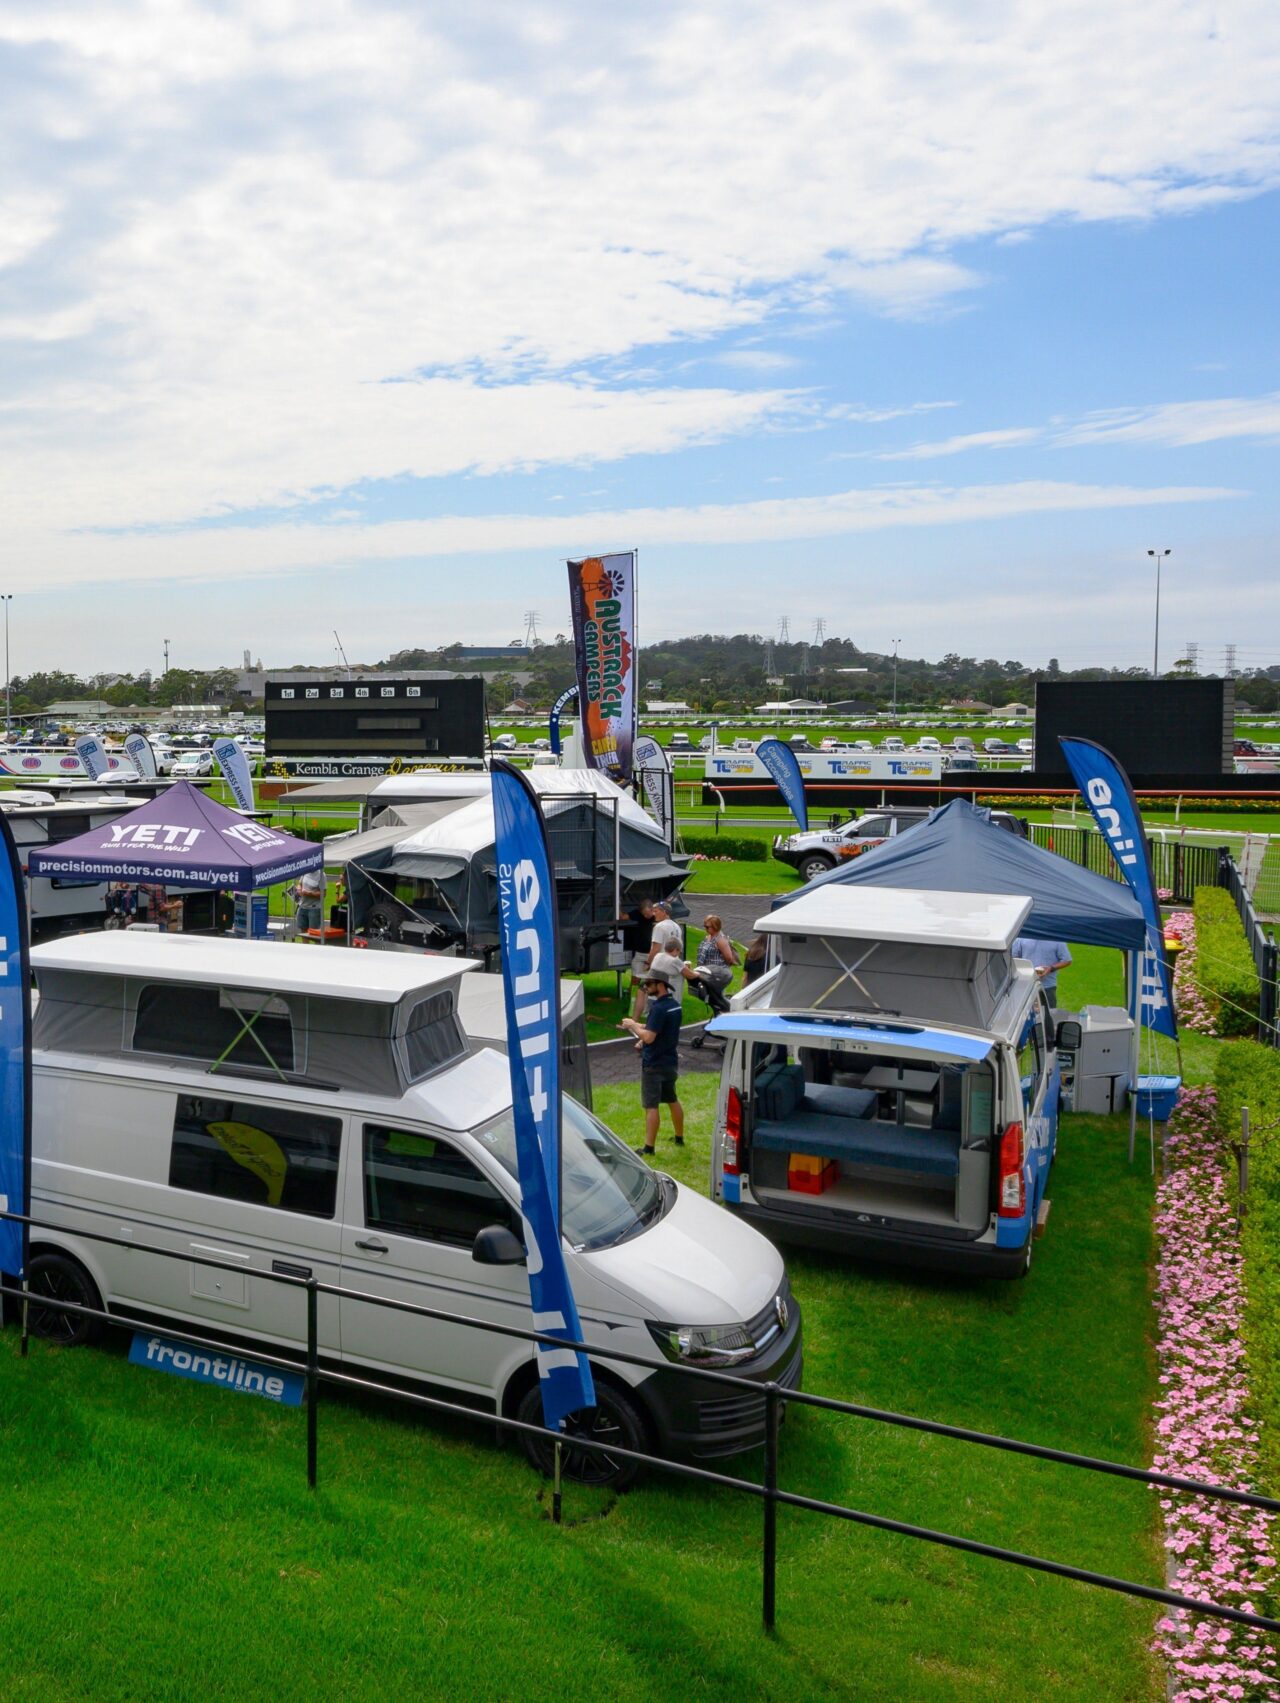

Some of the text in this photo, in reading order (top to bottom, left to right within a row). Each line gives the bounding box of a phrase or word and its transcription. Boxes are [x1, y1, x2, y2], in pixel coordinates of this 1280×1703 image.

[584, 620, 601, 703] CAMPERS
[594, 599, 622, 719] AUSTRACK
[283, 690, 292, 698] 1st
[306, 689, 318, 698] 2nd
[331, 688, 342, 697] 3rd
[357, 688, 368, 697] 4th
[383, 687, 394, 696] 5th
[408, 687, 419, 696] 6th
[131, 753, 146, 777] EXPRESS
[221, 759, 238, 786] EXPRESS
[296, 757, 466, 777] Kembla Grange Racours
[767, 746, 792, 779] Camping
[639, 760, 657, 793] ERESS
[762, 756, 795, 801] Accessories
[111, 824, 201, 846] YETI
[221, 823, 277, 845] YETI
[164, 845, 190, 853] WILD
[39, 860, 240, 885] precisionmotors.com.au/yeti
[146, 1338, 285, 1397] frontline
